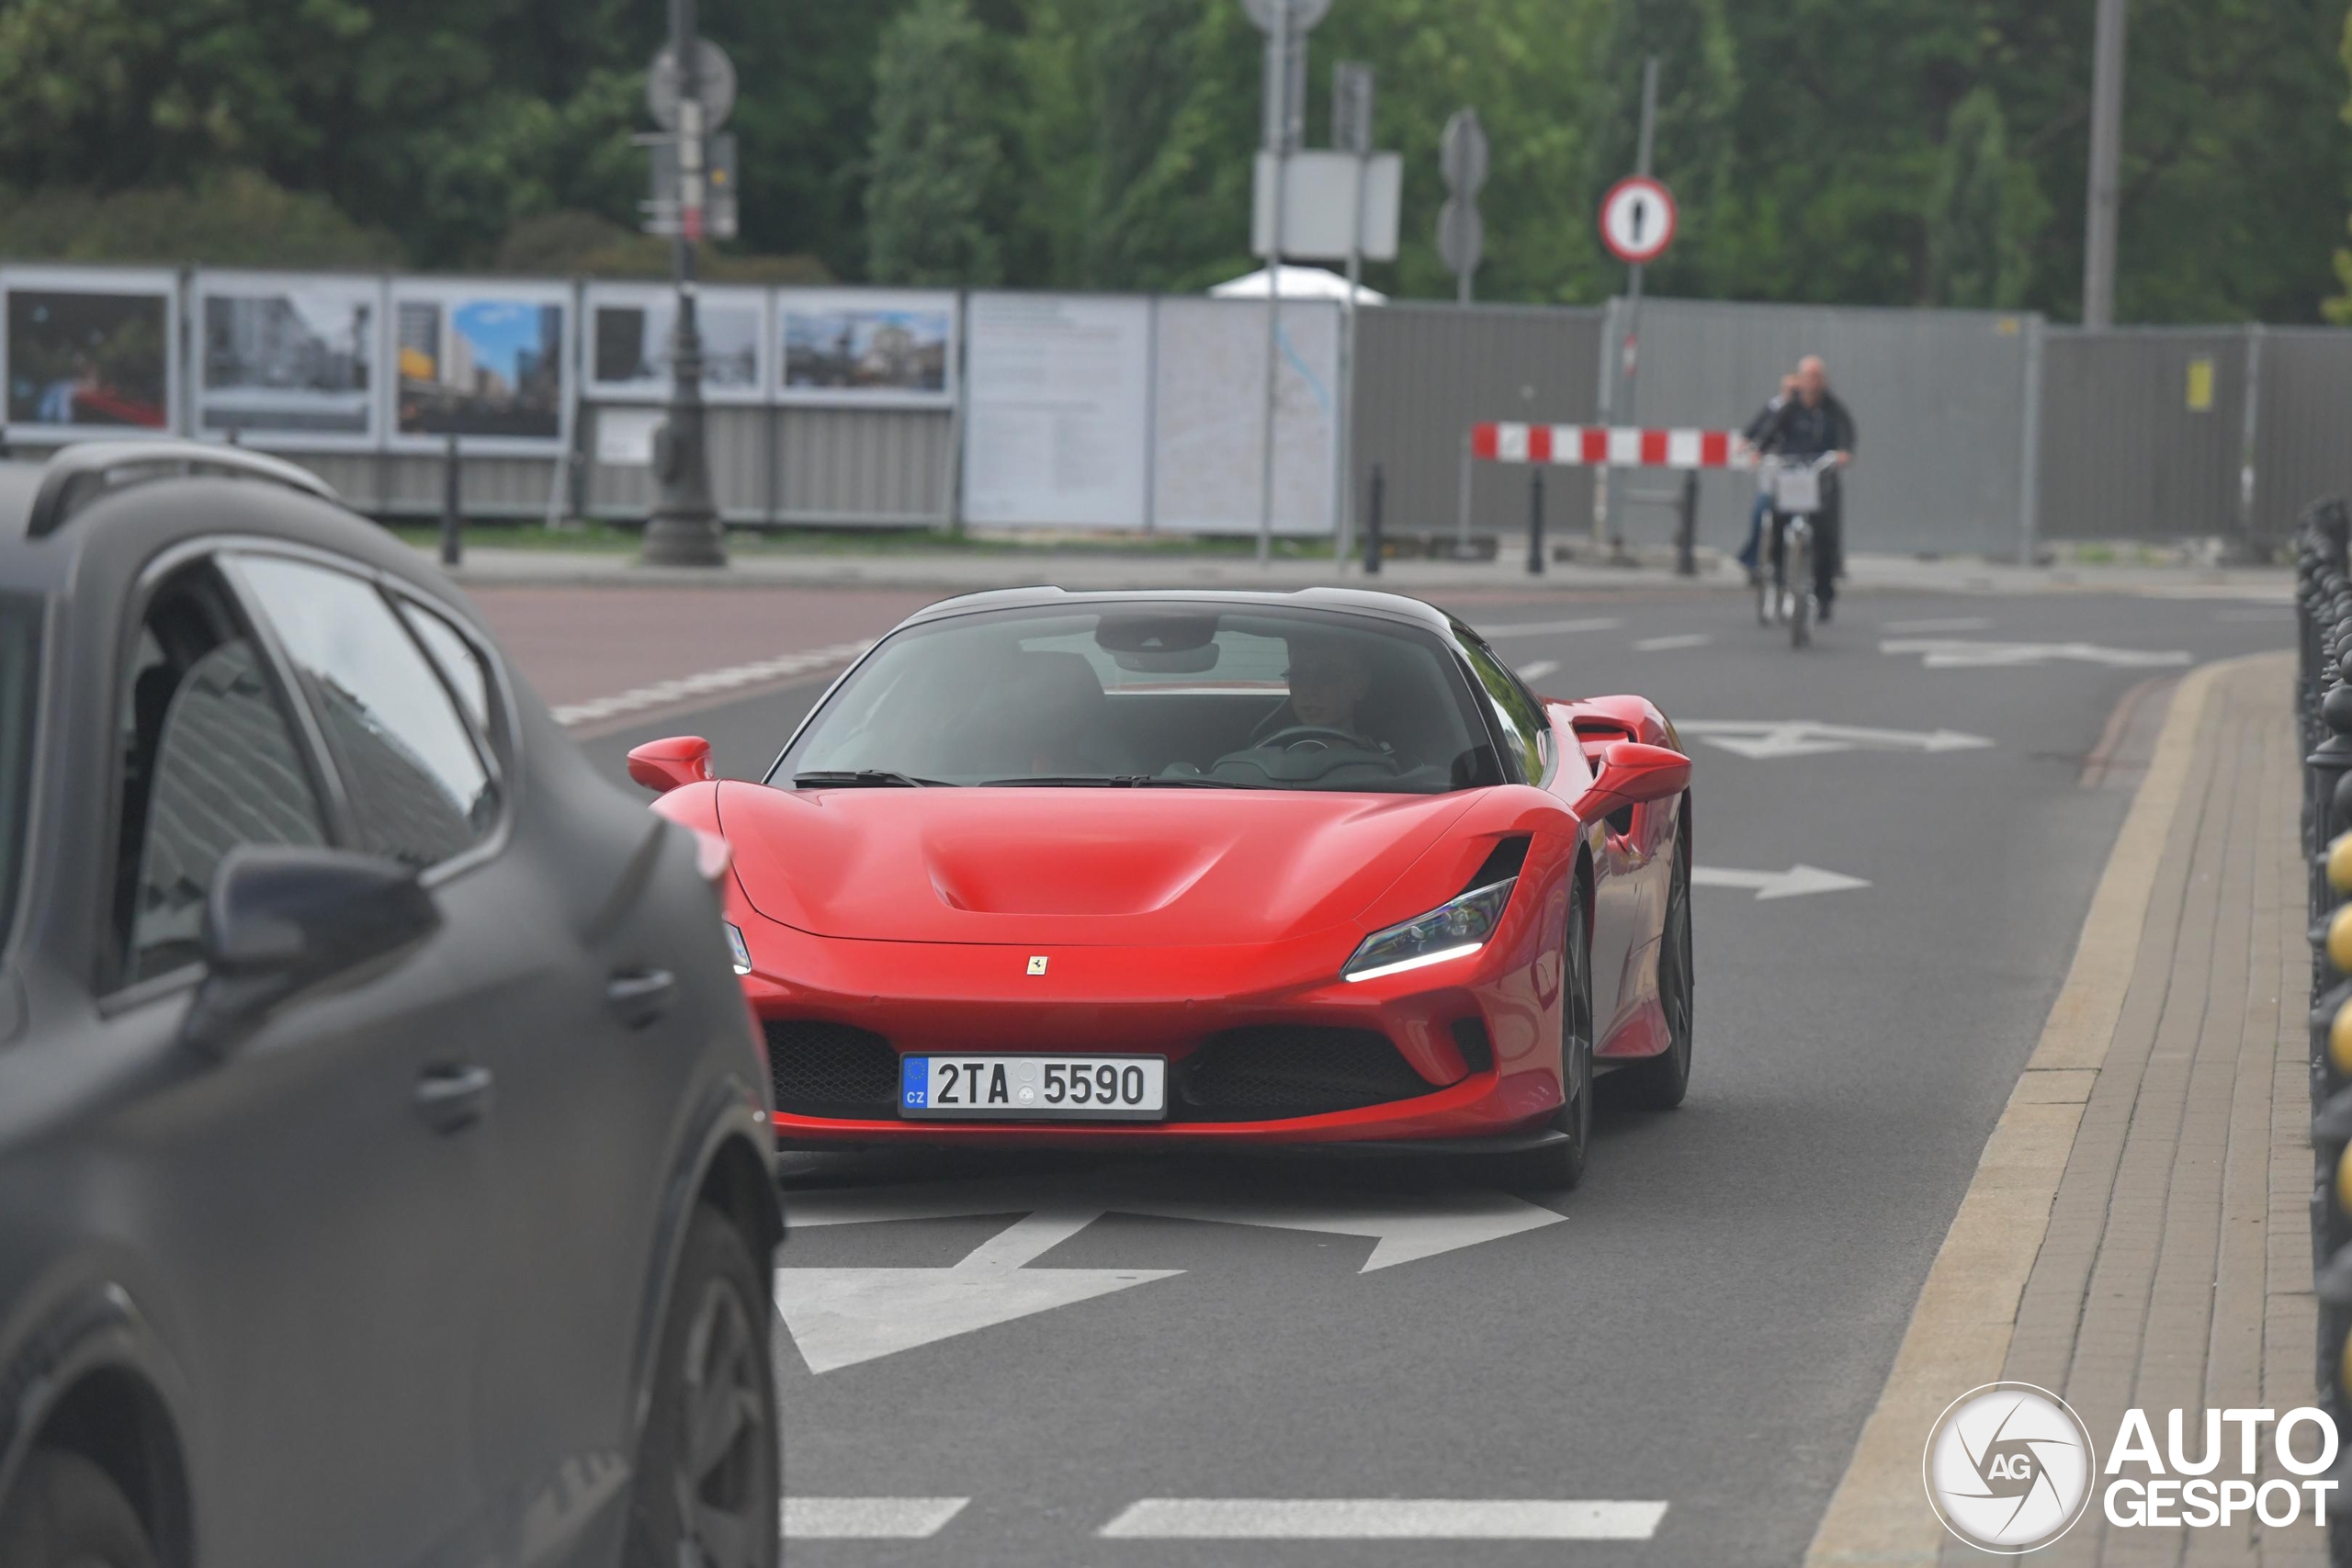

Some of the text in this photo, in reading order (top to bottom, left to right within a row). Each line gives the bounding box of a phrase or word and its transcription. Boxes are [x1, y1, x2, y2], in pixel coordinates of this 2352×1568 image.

[937, 1063, 1144, 1105] 2TA 5590
[907, 1092, 924, 1104] CZ
